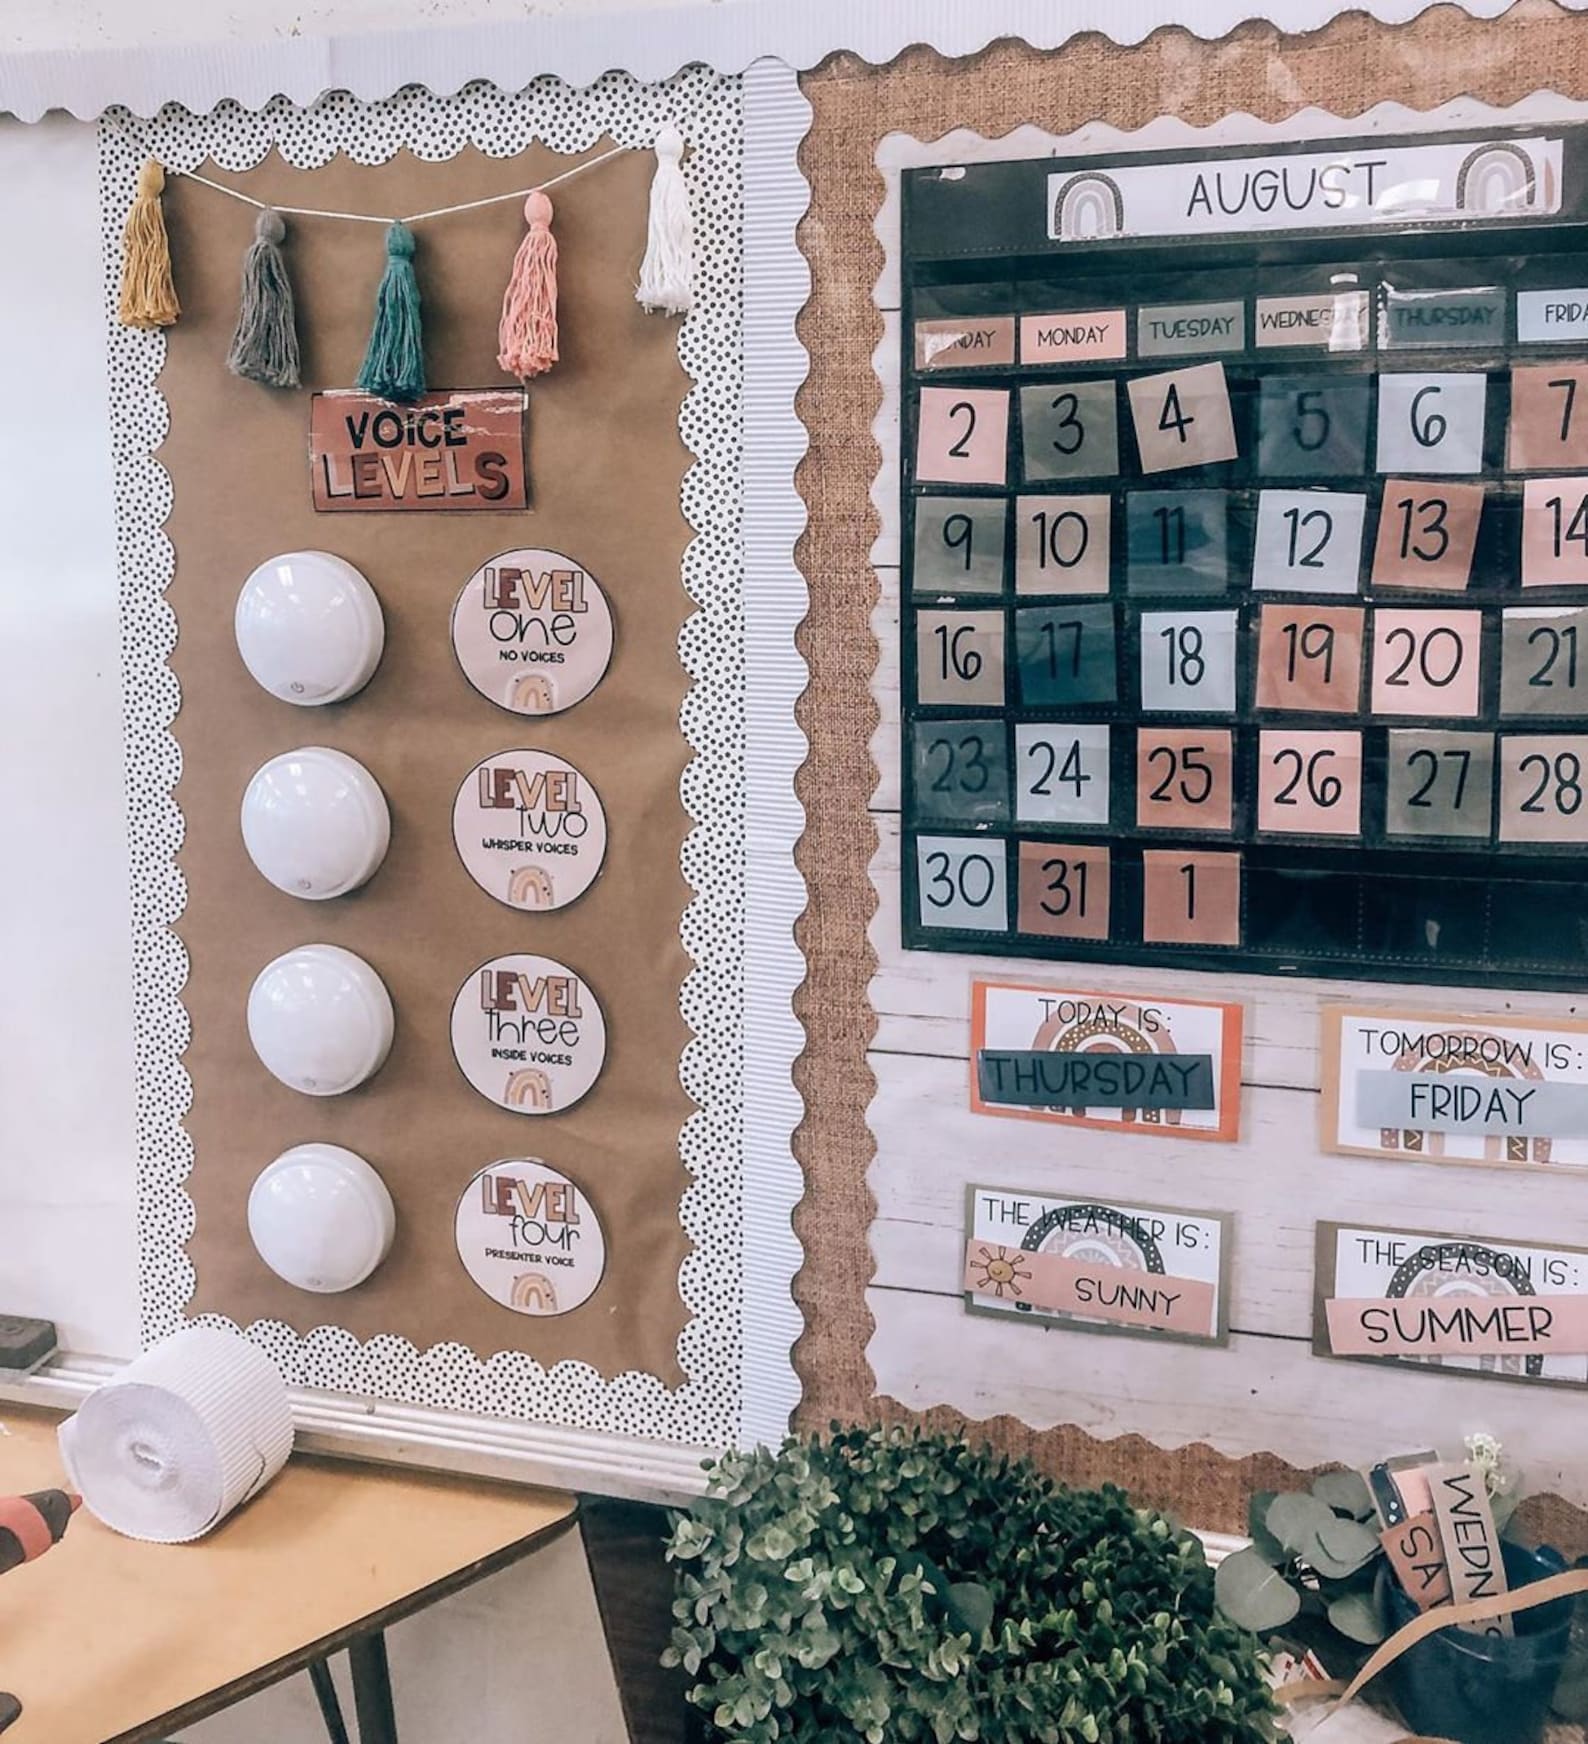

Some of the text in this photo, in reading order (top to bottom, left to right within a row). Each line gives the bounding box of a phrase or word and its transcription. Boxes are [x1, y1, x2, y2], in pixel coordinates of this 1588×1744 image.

[1187, 161, 1387, 217] AUGUST
[1037, 325, 1109, 347] MONDAY
[1150, 317, 1235, 340] TUESDAY
[1396, 305, 1497, 328] THURSDAY
[346, 409, 467, 449] VOICE
[948, 401, 977, 458] 2
[1052, 392, 1085, 456] 3
[1158, 383, 1194, 444] 4
[1294, 390, 1331, 453] 5
[1410, 385, 1447, 447] 6
[1548, 379, 1577, 441] 7
[320, 451, 511, 500] LEVELS
[943, 513, 972, 571] 9
[1031, 509, 1088, 569] 10
[1153, 506, 1186, 565] 11
[1282, 508, 1332, 569] 12
[1398, 498, 1450, 562] 13
[1545, 495, 1588, 558] 14
[483, 567, 588, 613] LEVEL
[489, 612, 577, 646] one
[499, 650, 565, 664] NO VOICES
[934, 625, 982, 681] 16
[1041, 621, 1084, 680] 17
[1161, 625, 1205, 686] 18
[1282, 622, 1334, 683] 19
[1384, 626, 1463, 687] 20
[1528, 626, 1577, 688] 21
[479, 768, 582, 812] LEVEL
[928, 735, 990, 793] 23
[1028, 740, 1091, 798] 24
[1148, 746, 1212, 803] 25
[1273, 749, 1342, 807] 26
[1408, 749, 1471, 810] 27
[1519, 752, 1582, 815] 28
[482, 838, 578, 856] WHISPER VOICES
[516, 805, 588, 838] two
[925, 852, 994, 908] 30
[1040, 859, 1087, 918] 31
[1180, 863, 1196, 920] 1
[481, 969, 582, 1018] LEVEL
[1038, 998, 1172, 1033] TODAY IS:
[484, 1008, 580, 1047] three
[1358, 1028, 1583, 1070] TOMORROW IS:
[492, 1048, 572, 1066] INSIDE VOICES
[984, 1056, 1201, 1097] THURSDAY
[1411, 1083, 1536, 1125] FRIDAY
[482, 1174, 580, 1225] LEVEL
[982, 1198, 1210, 1249] THE WEATHER IS:
[485, 1248, 575, 1267] PRESENTER VOICE
[509, 1214, 581, 1251] four
[1355, 1238, 1579, 1287] THE SEASON IS:
[1075, 1278, 1182, 1316] SUNNY
[1360, 1306, 1554, 1344] SUMMER
